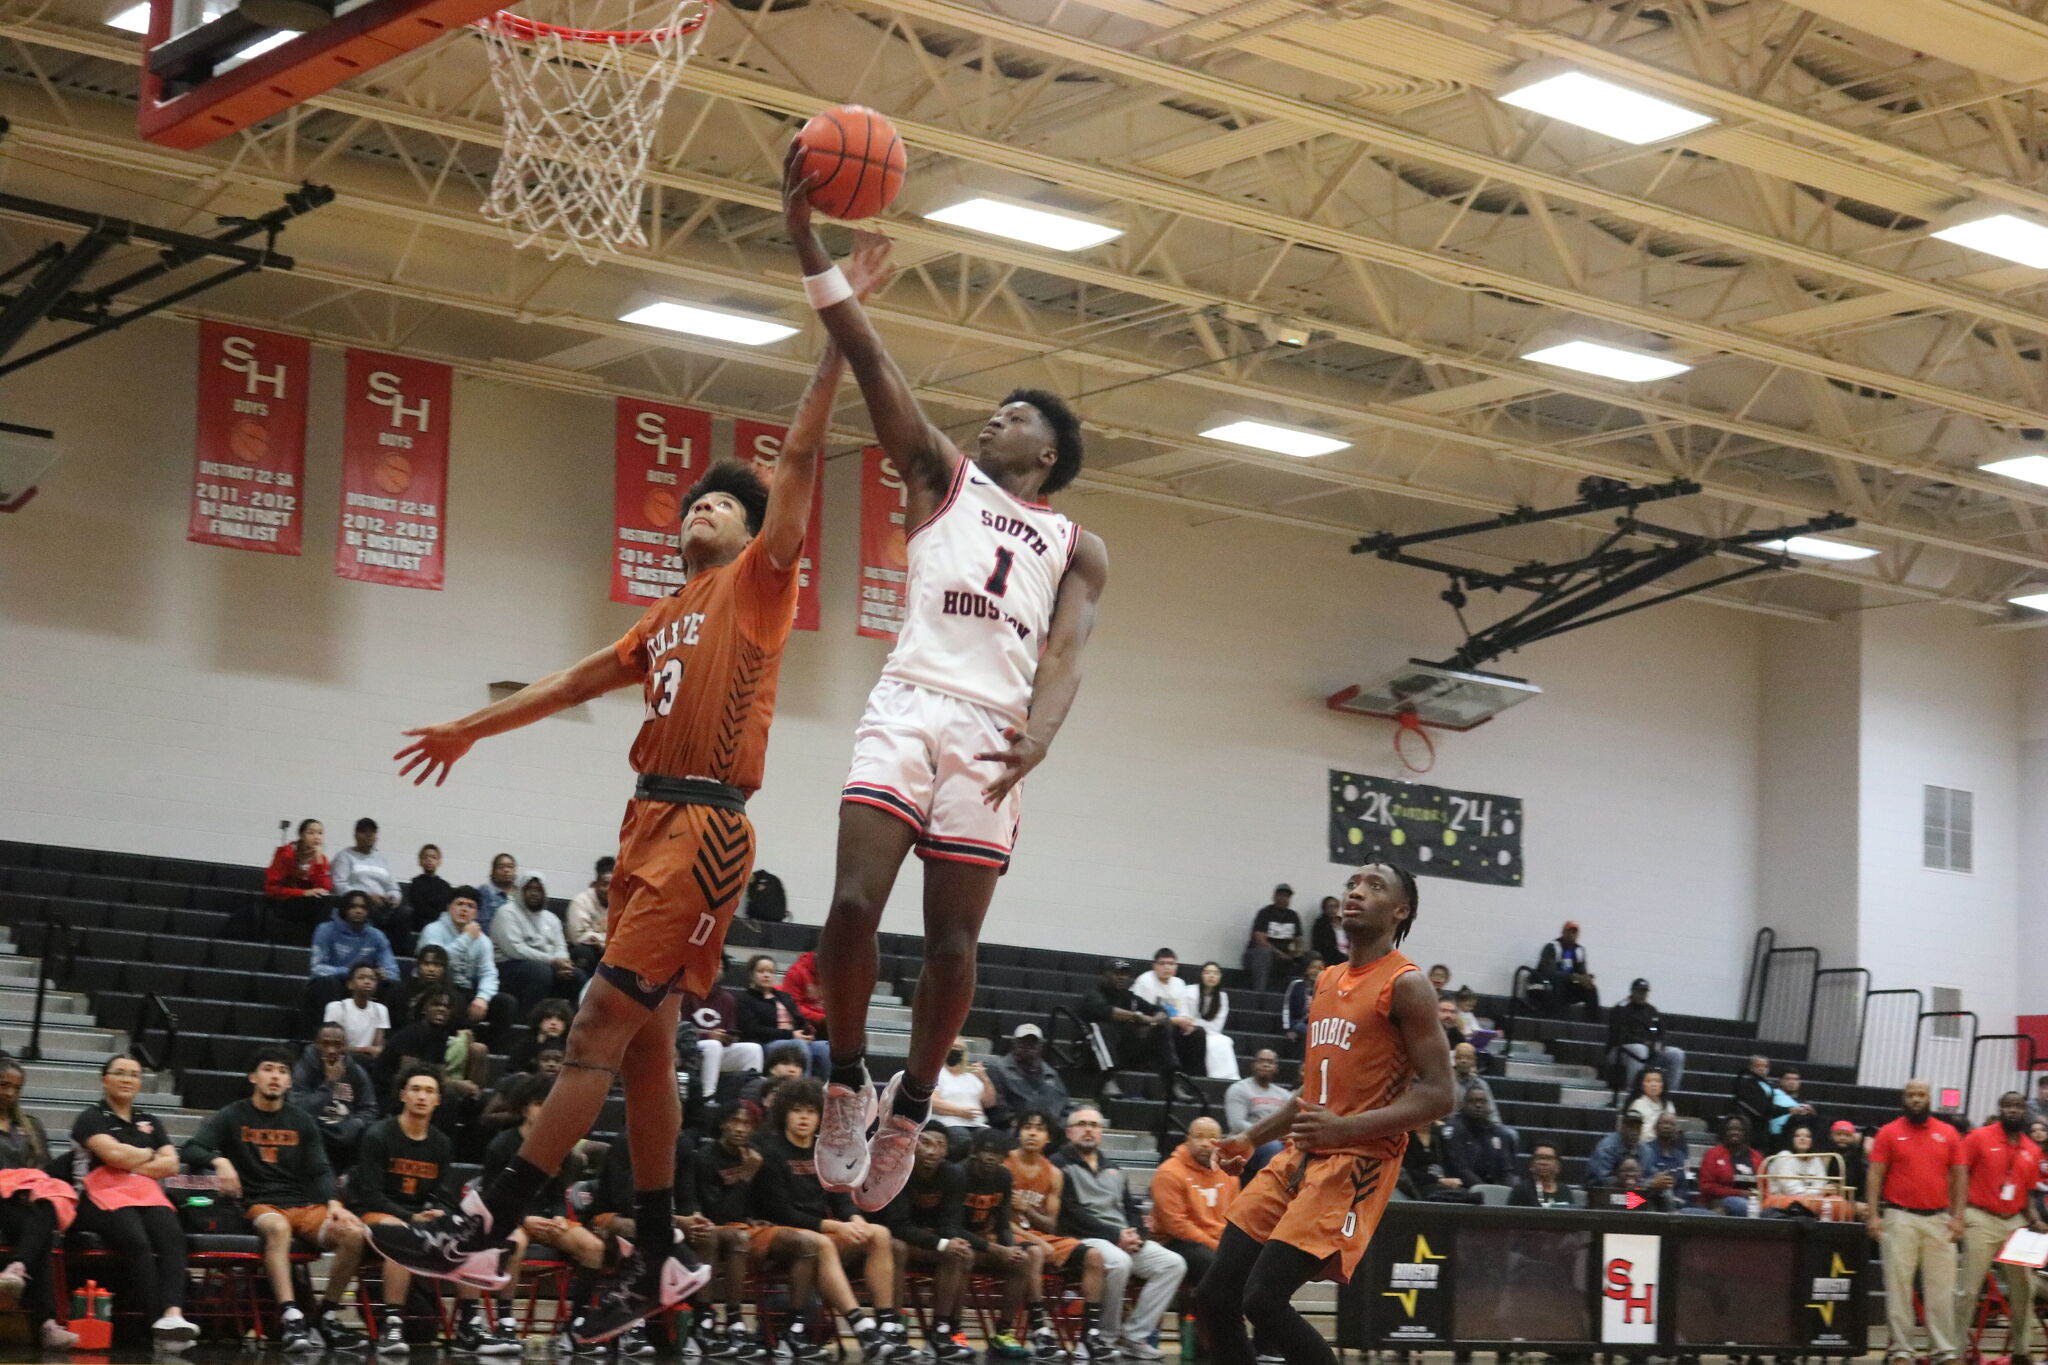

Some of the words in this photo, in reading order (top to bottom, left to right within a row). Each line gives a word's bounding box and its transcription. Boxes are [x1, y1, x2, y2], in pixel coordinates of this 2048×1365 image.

[221, 336, 287, 400] SH
[232, 398, 270, 417] BOYS
[366, 371, 431, 433] SH
[634, 412, 692, 469] SH
[754, 434, 783, 467] S
[199, 461, 255, 481] DISTRICT
[199, 499, 292, 528] BI-DISTRICT
[346, 492, 398, 512] DISTRICT
[208, 518, 279, 542] FINALIST
[345, 530, 434, 556] BI-DISTRICT
[618, 527, 666, 545] DISTRICT
[981, 509, 1049, 557] SOUTH
[356, 548, 422, 571] FINALIST
[984, 544, 1015, 599] 1
[1358, 791, 1397, 827] 2K
[1448, 796, 1493, 837] 24
[688, 911, 716, 946] D
[692, 1006, 722, 1029] C
[1310, 1017, 1357, 1051] DOBIE
[1318, 1058, 1329, 1105] 1
[1603, 1257, 1656, 1325] SH
